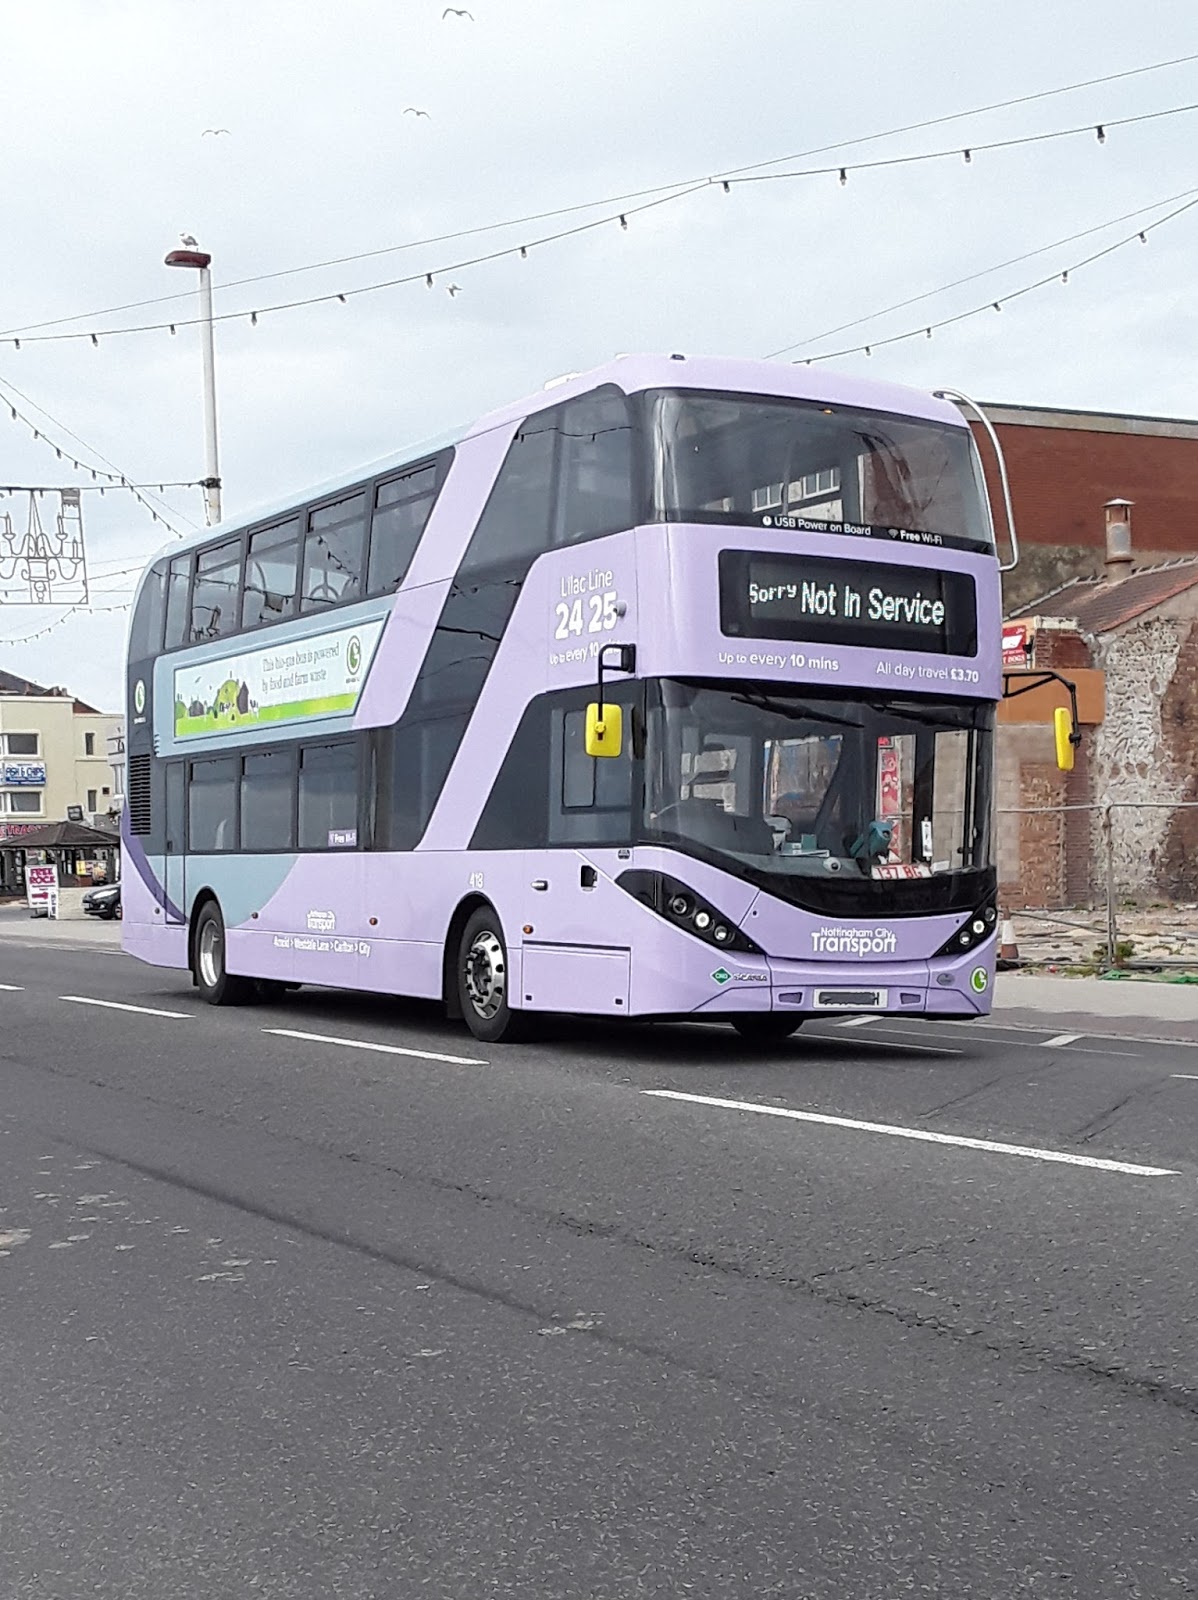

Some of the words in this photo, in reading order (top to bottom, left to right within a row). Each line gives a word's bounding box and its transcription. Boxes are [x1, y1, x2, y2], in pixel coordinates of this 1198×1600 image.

[774, 517, 796, 528] USB
[798, 519, 828, 530] Power
[830, 524, 842, 532] on
[844, 526, 871, 536] Board
[900, 530, 920, 542] Free
[922, 532, 942, 545] Wi-Fi
[561, 575, 586, 597] Lilac
[588, 569, 613, 590] Line
[750, 584, 797, 604] Sorry
[802, 581, 837, 616] Not
[844, 586, 860, 618] In
[868, 588, 944, 625] Service
[555, 599, 584, 640] 24
[588, 591, 618, 633] 25
[590, 642, 599, 658] 10
[718, 652, 734, 664] Up
[736, 654, 746, 664] to
[750, 654, 786, 668] every
[790, 654, 804, 668] 10
[808, 656, 839, 670] mins
[876, 662, 891, 674] All
[894, 664, 916, 679] day
[918, 666, 948, 680] travel
[950, 668, 979, 682] £3.70
[30, 868, 54, 876] FREE
[30, 876, 56, 884] ROCK
[820, 926, 873, 939] Nottingham
[874, 928, 892, 940] City
[811, 932, 896, 957] Transport
